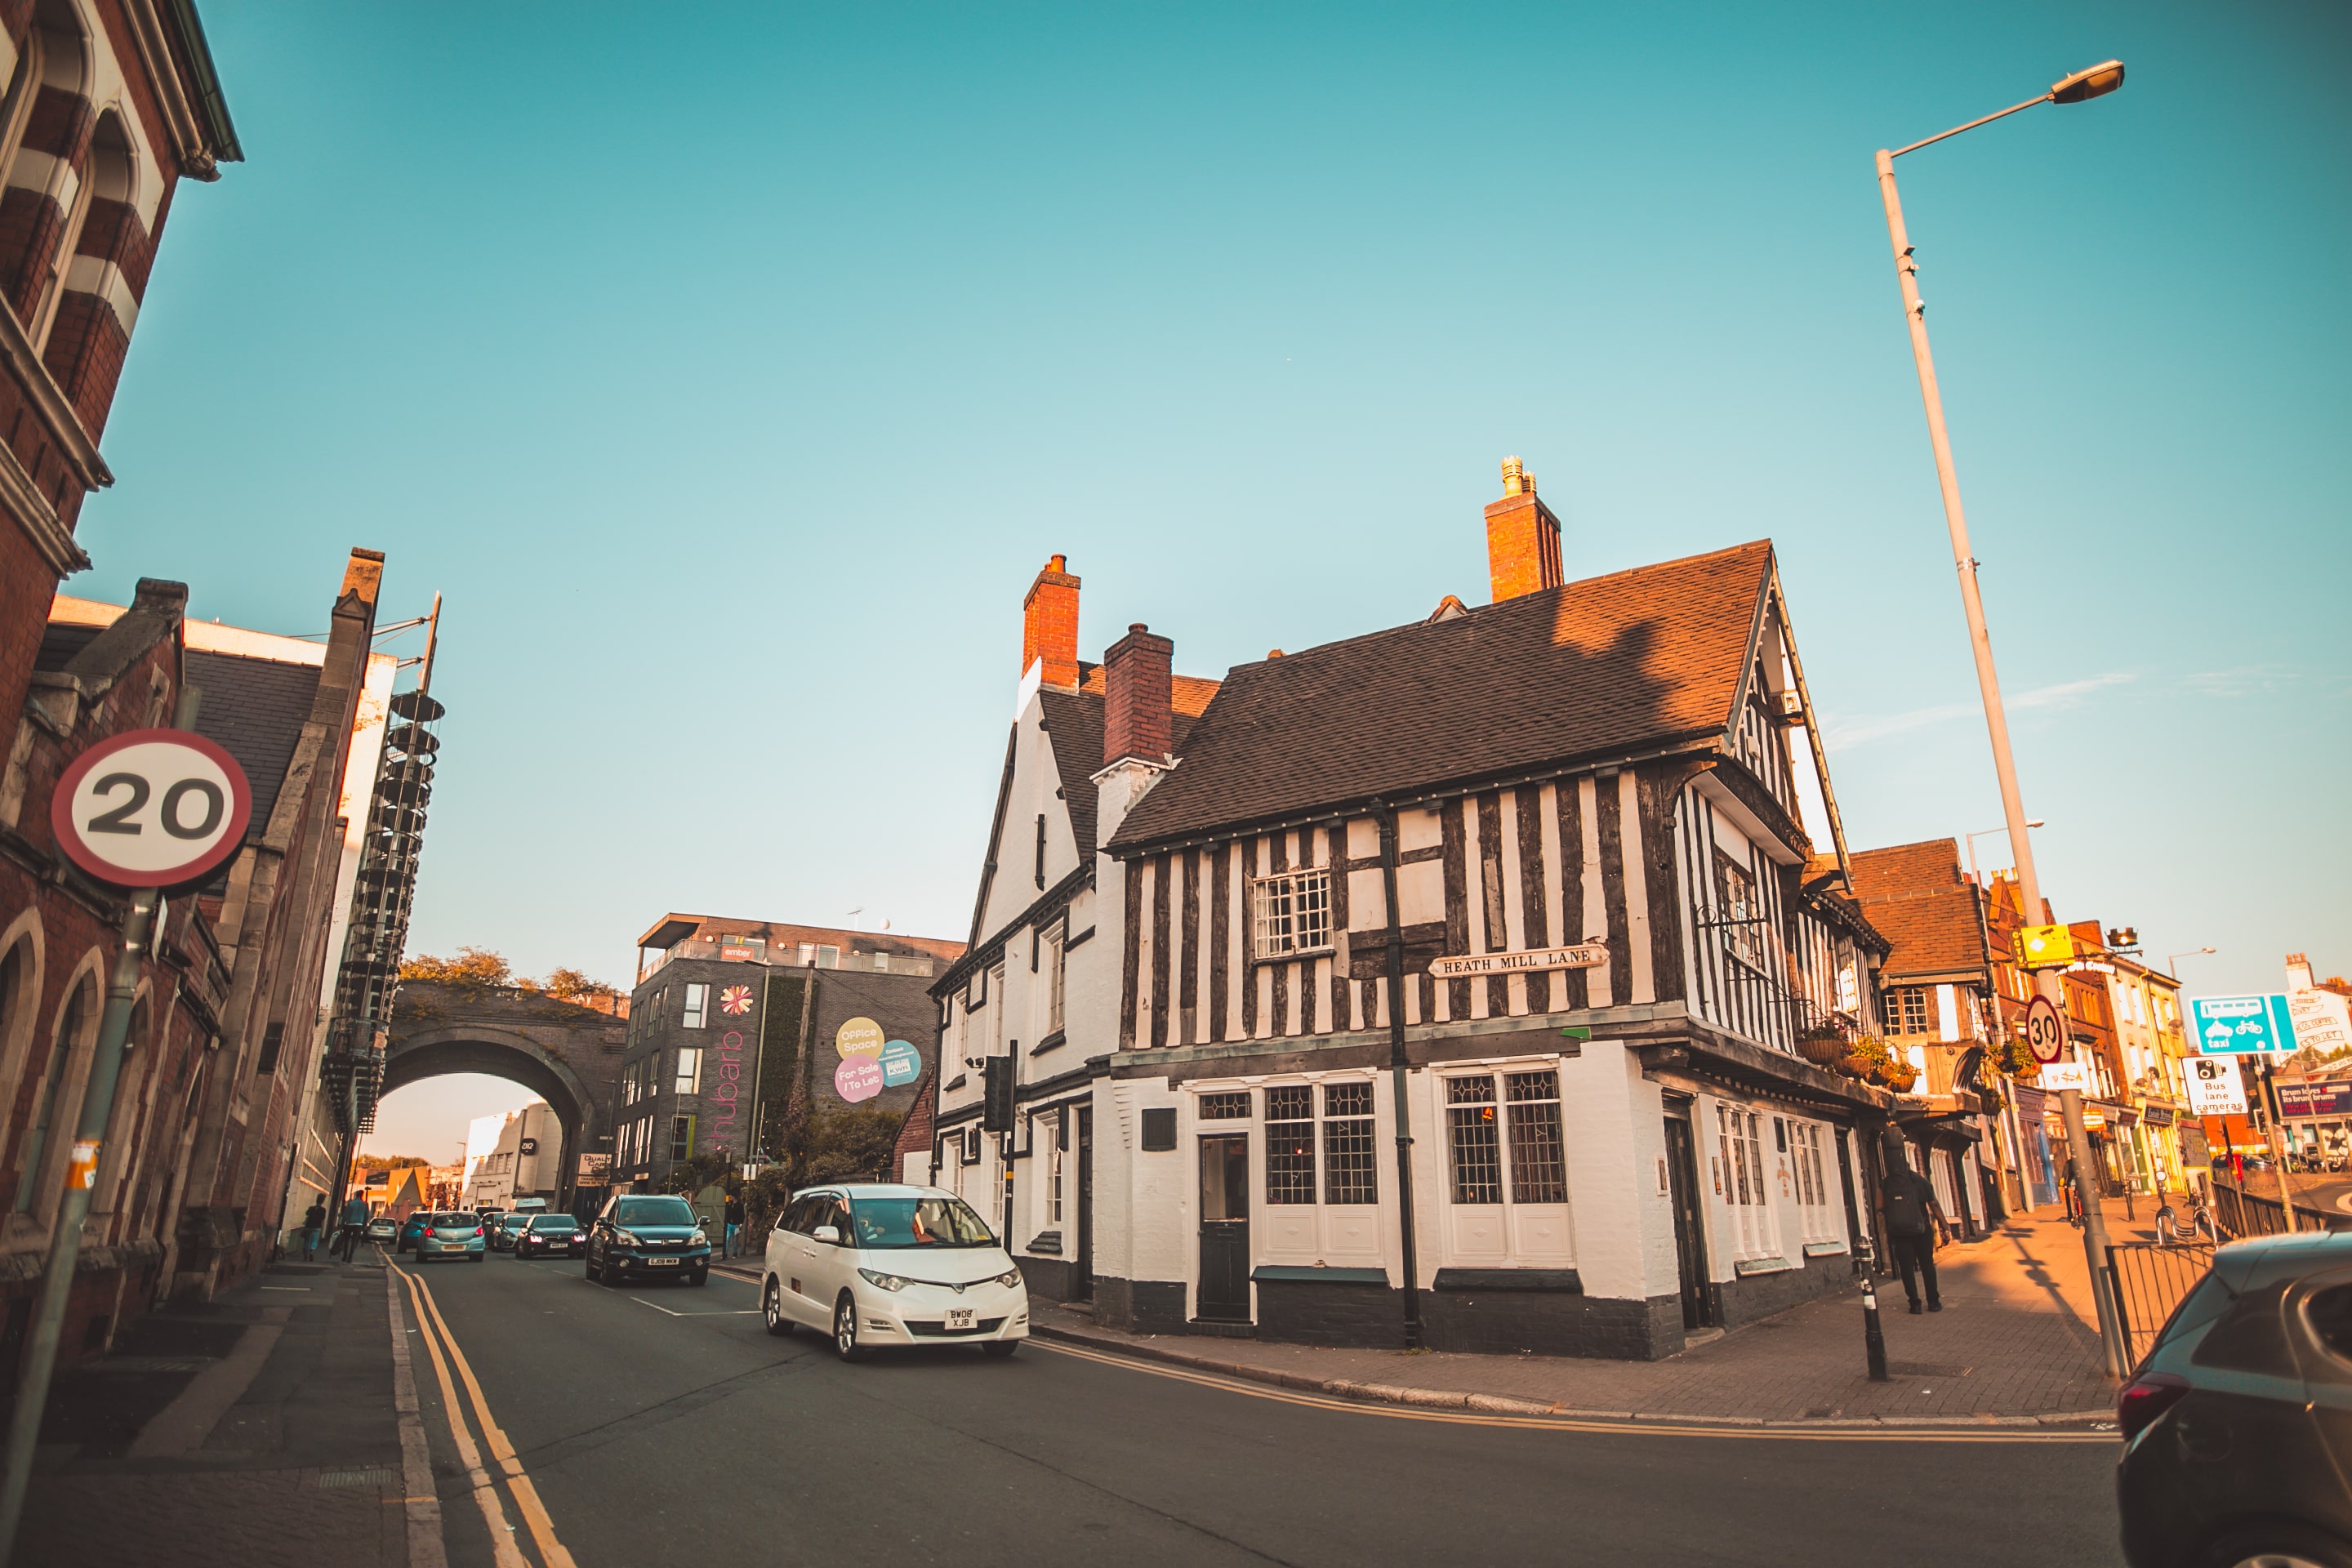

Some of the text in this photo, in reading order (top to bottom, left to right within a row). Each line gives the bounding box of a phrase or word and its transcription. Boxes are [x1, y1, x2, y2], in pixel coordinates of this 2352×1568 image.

[87, 772, 225, 840] 20
[724, 949, 751, 957] ember
[2011, 931, 2024, 964] CCTV
[1444, 950, 1590, 973] HEATH MILL LANE
[841, 1028, 876, 1040] Office
[2031, 1015, 2056, 1046] 30
[2323, 1031, 2336, 1039] LET
[844, 1040, 877, 1054] Space
[2207, 1038, 2230, 1049] taxi
[839, 1063, 879, 1081] For Sale
[862, 1076, 880, 1086] Let
[2196, 1102, 2243, 1111] cameras
[951, 1309, 973, 1318] BW08
[953, 1319, 969, 1327] XJB
